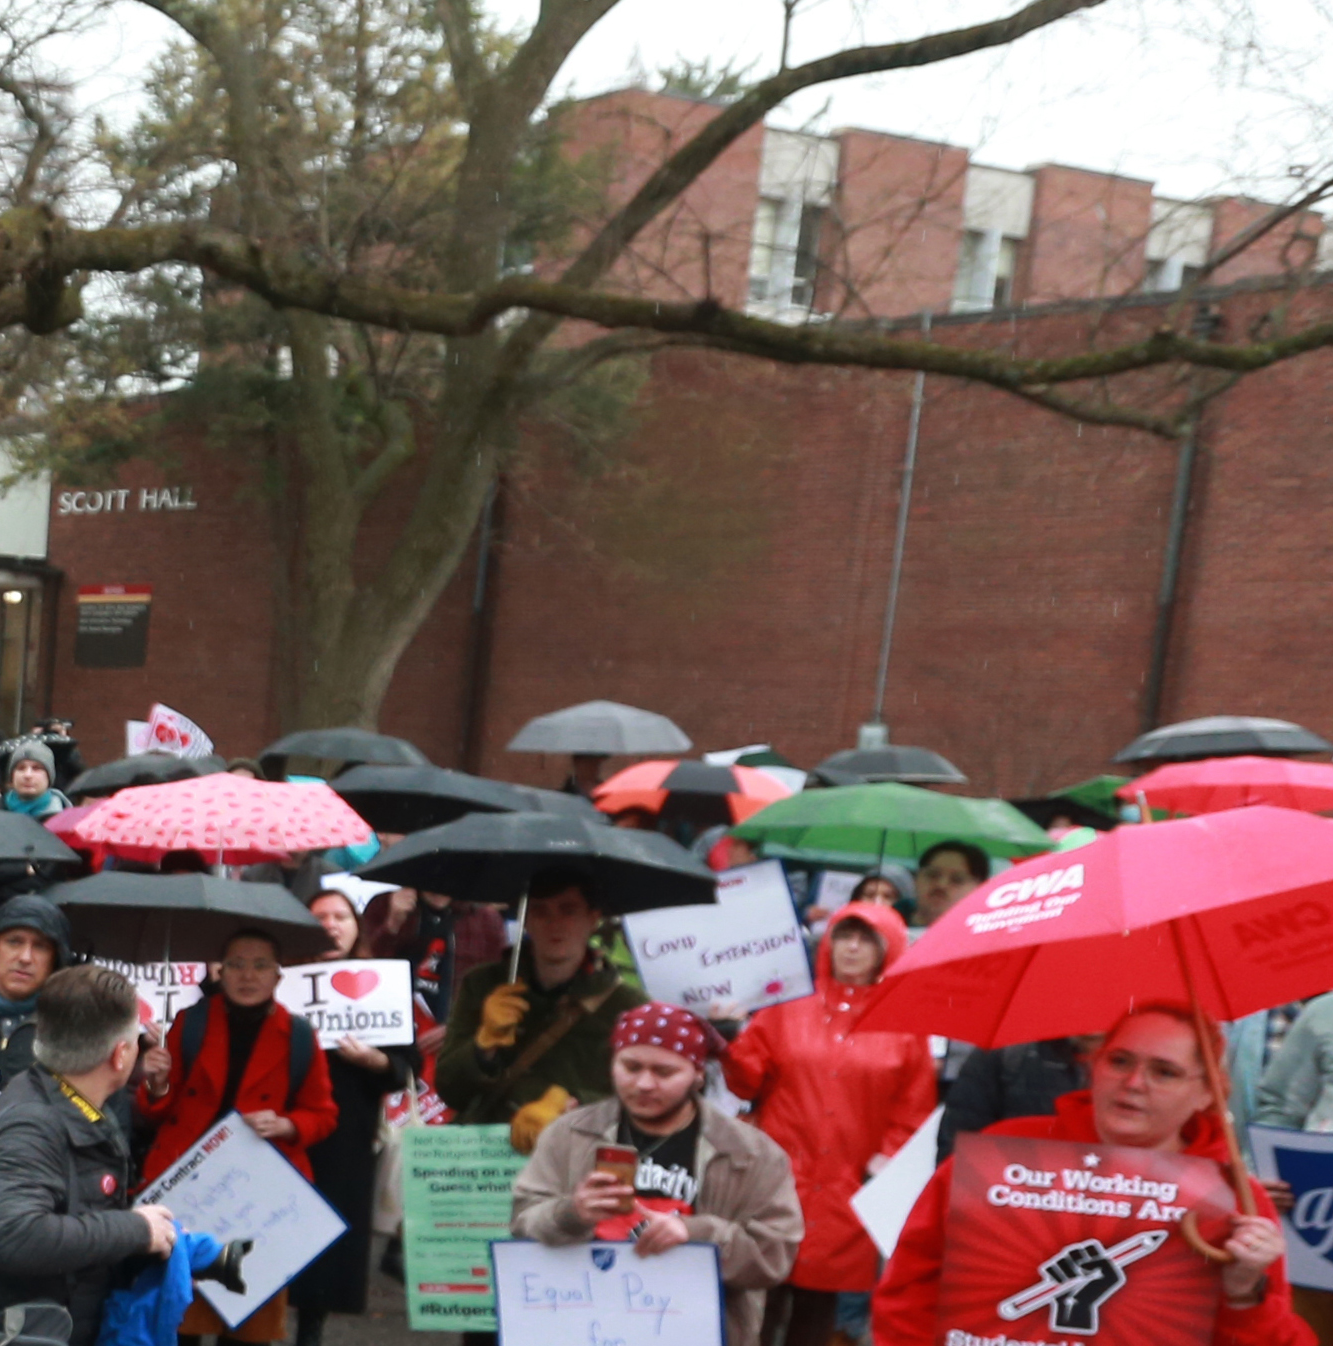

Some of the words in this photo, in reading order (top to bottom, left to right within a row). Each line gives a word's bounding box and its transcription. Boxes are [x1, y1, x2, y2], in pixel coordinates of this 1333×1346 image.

[59, 489, 130, 515] SCOTT
[139, 486, 197, 512] HALL
[986, 863, 1084, 908] CWA
[302, 972, 329, 1007] I
[682, 980, 733, 1004] NOW
[162, 1150, 206, 1192] Contract
[201, 1126, 233, 1155] NOW!
[987, 1184, 1132, 1219] Conditions
[1004, 1163, 1057, 1188] Our
[1062, 1168, 1179, 1204] Working
[521, 1270, 593, 1313] Equal
[621, 1271, 672, 1336] Pay
